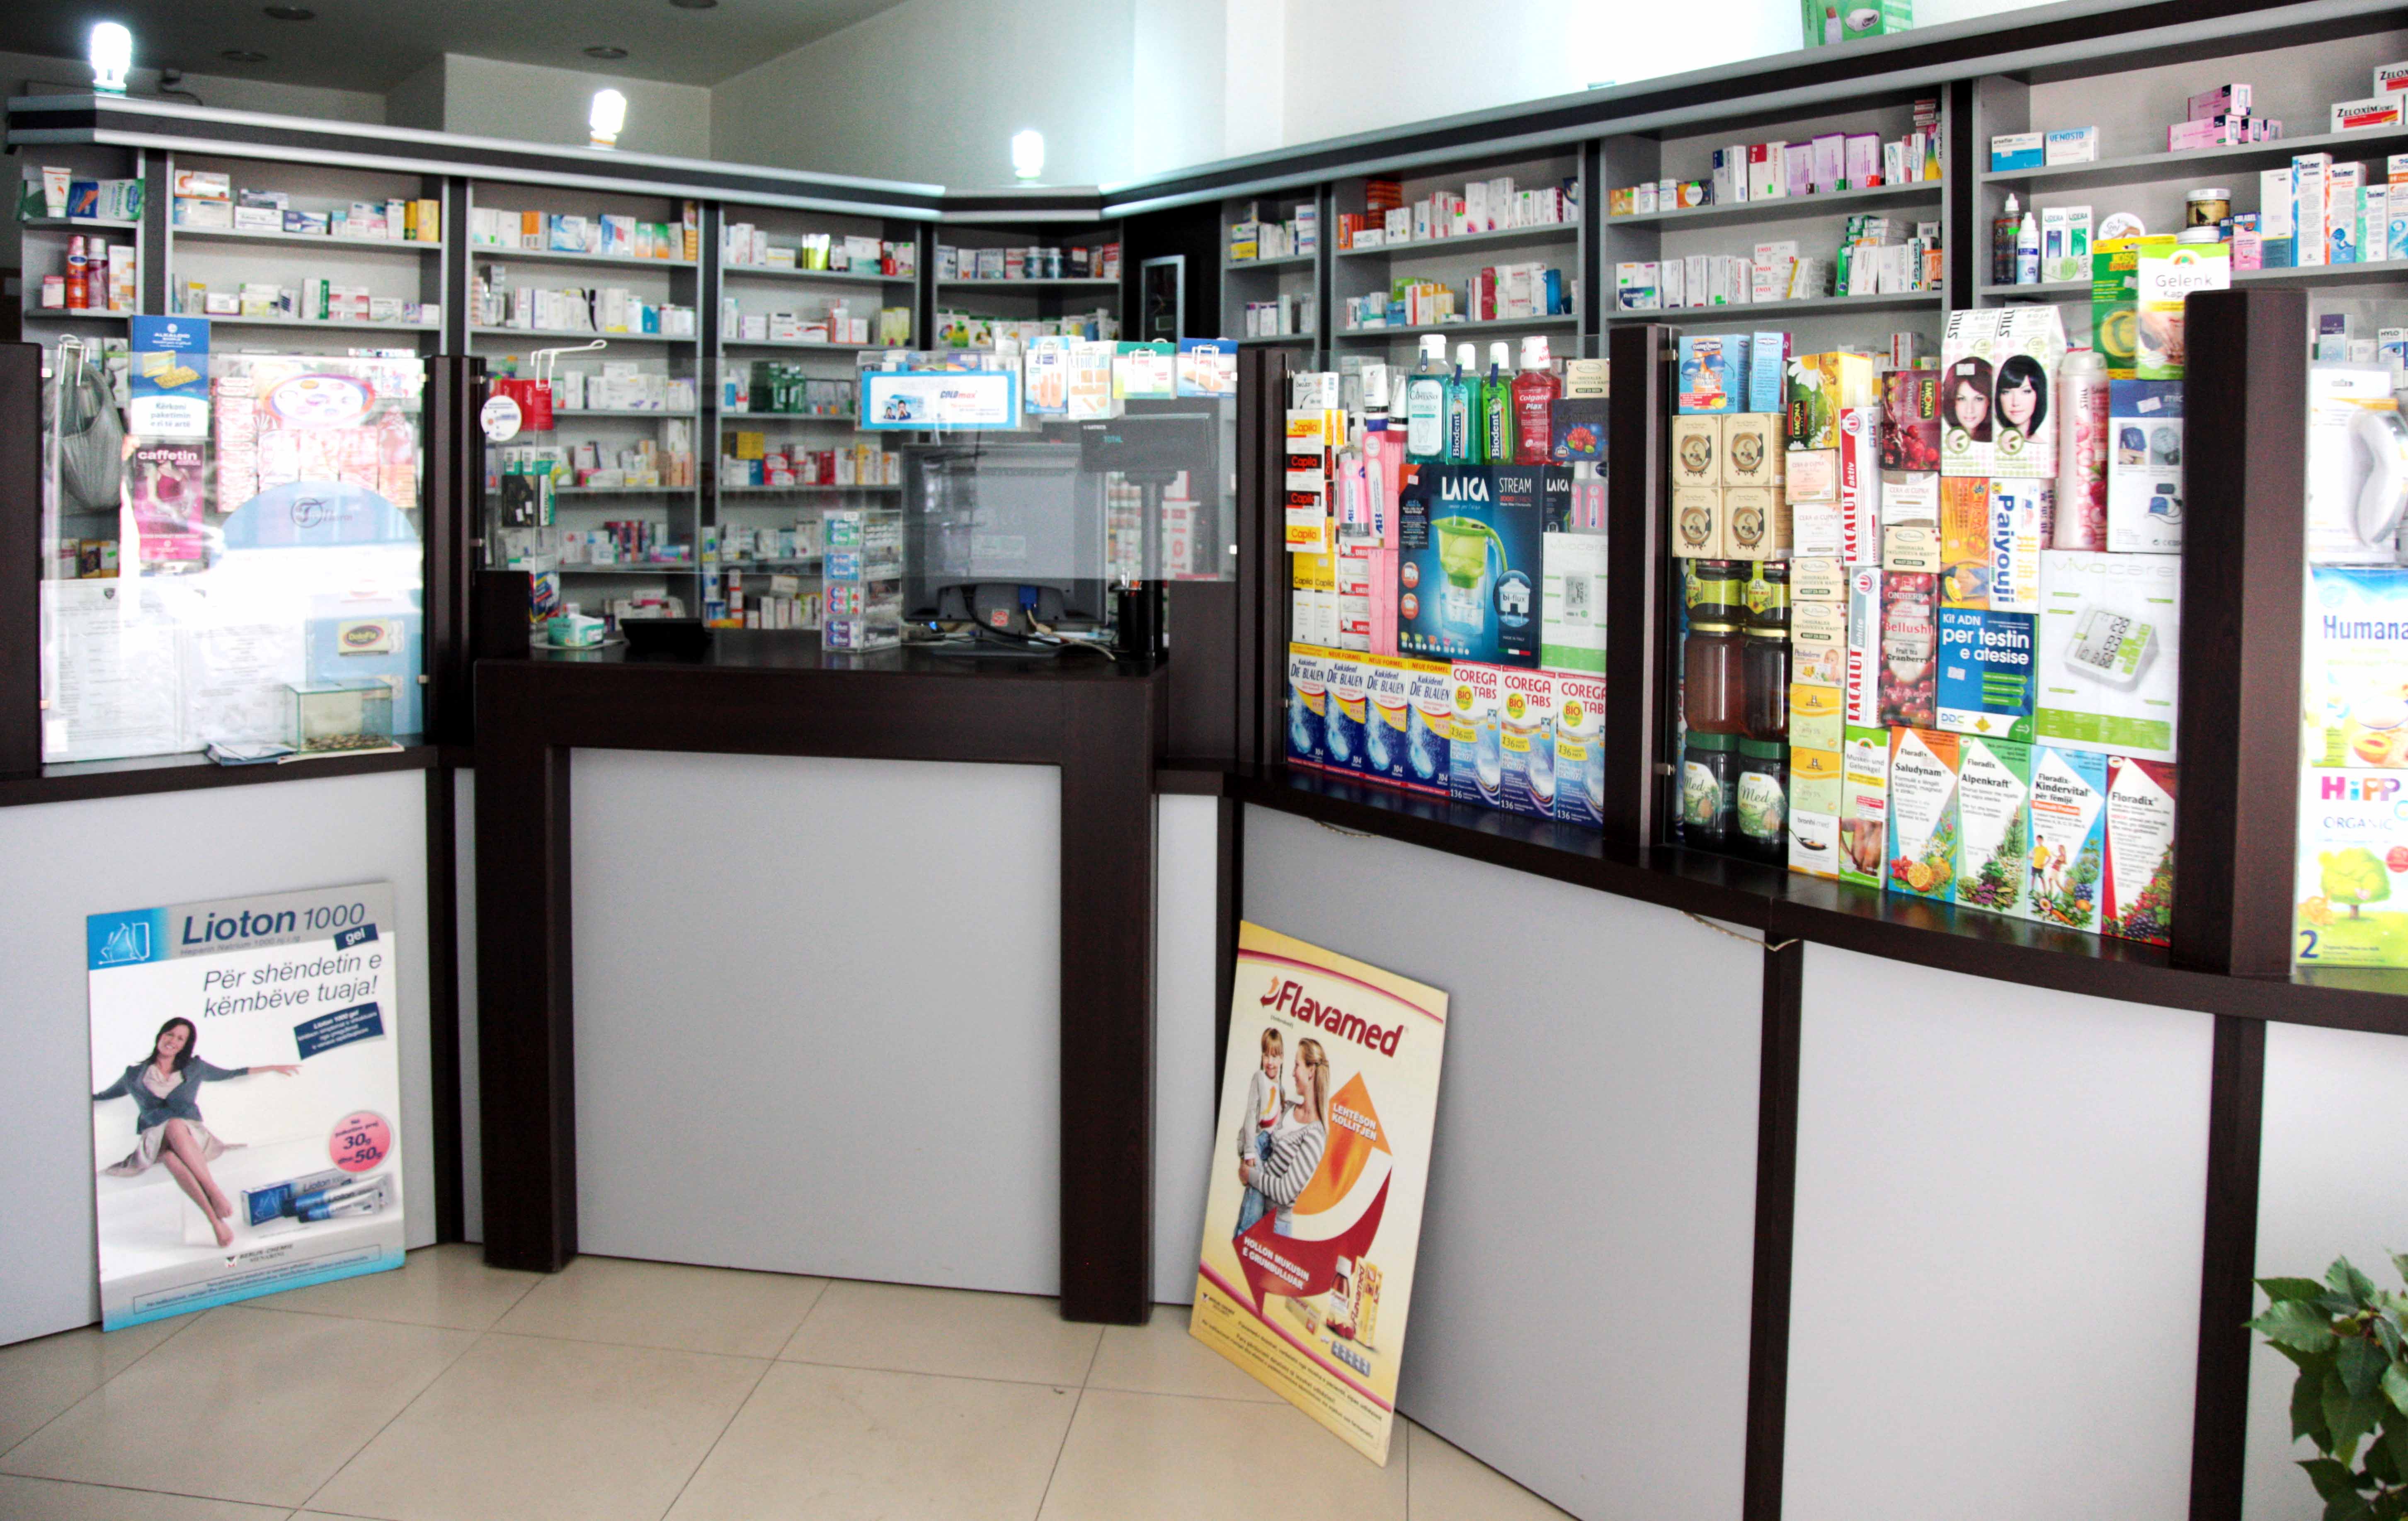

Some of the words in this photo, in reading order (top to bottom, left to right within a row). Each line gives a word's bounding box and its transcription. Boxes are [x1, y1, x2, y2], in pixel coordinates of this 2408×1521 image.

[2156, 274, 2213, 287] Gelenk
[1947, 311, 1964, 340] STILL
[1999, 309, 2015, 338] STILL
[1519, 394, 1549, 403] Colgate
[138, 449, 198, 461] caffetin
[1442, 476, 1490, 502] LAICA
[1499, 478, 1532, 494] STREAM
[1546, 478, 1569, 492] LAICA
[1843, 490, 1857, 562] LACALUT
[1993, 495, 2015, 602] Paiyouji
[1942, 613, 1955, 623] Kit
[1957, 614, 1981, 626] ADN
[2323, 615, 2408, 640] Humana
[1942, 628, 1974, 645] per
[1979, 627, 2030, 649] testin
[1959, 648, 1970, 660] e
[1974, 647, 2029, 665] atesise
[1426, 664, 1448, 674] FORMEL
[1453, 668, 1497, 686] COREGA
[1473, 686, 1497, 700] TABS
[1504, 675, 1551, 694] COREGA
[1561, 682, 1606, 701] COREGA
[1848, 648, 1863, 722] LACALUT
[1457, 690, 1472, 701] BIO
[1508, 698, 1523, 709] BIO
[1525, 694, 1551, 708] TABS
[1565, 705, 1581, 716] BIO
[1582, 701, 1605, 714] TAB
[1962, 774, 2010, 788] Alpenkraft
[2035, 781, 2088, 797] Kindervital
[2321, 776, 2401, 801] HiPP
[1740, 785, 1770, 803] Med
[2111, 791, 2155, 807] Floradix
[1501, 799, 1513, 810] 136
[1557, 810, 1570, 820] 136
[181, 910, 297, 946] Lioton
[303, 902, 365, 931] 1000
[344, 928, 366, 947] gel
[2299, 929, 2319, 959] 2
[203, 970, 245, 992] Për
[252, 954, 361, 985] shëndetin
[369, 955, 383, 968] e
[204, 987, 310, 1018] këmbëve
[318, 975, 378, 1003] tuaja!
[1276, 980, 1404, 1058] Flavamed
[1332, 1102, 1377, 1129] LEHTËSON
[1331, 1113, 1377, 1142] KOLLITJEN
